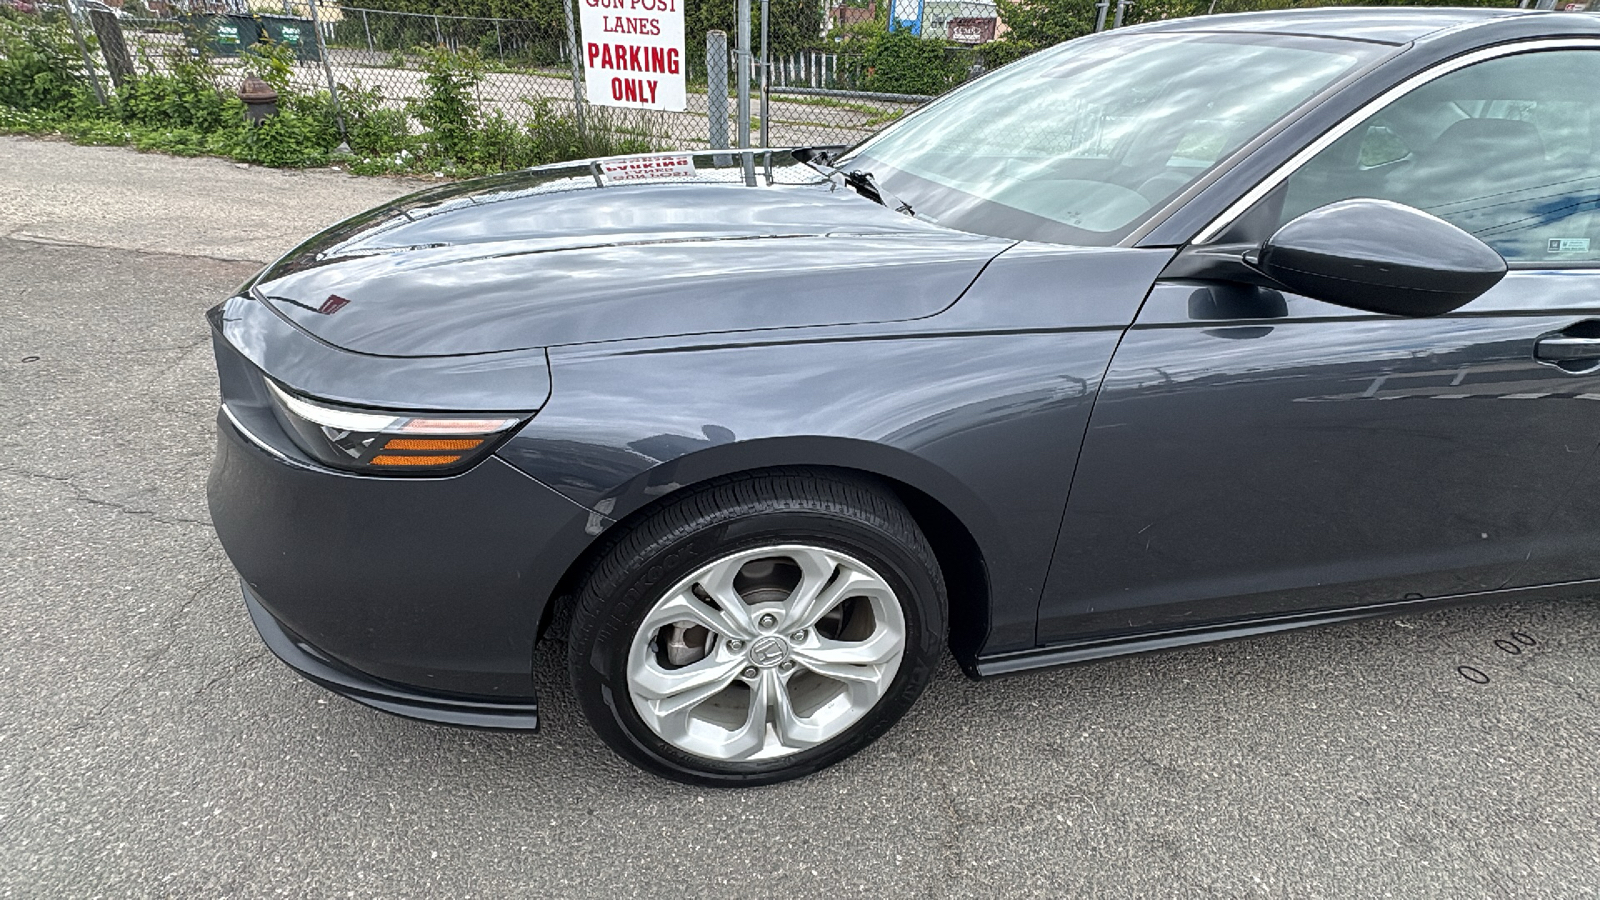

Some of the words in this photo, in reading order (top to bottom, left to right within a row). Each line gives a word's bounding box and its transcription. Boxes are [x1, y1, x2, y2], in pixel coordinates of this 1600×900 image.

[603, 16, 660, 35] LANES
[587, 42, 679, 74] PARKING
[611, 77, 658, 104] ONLY
